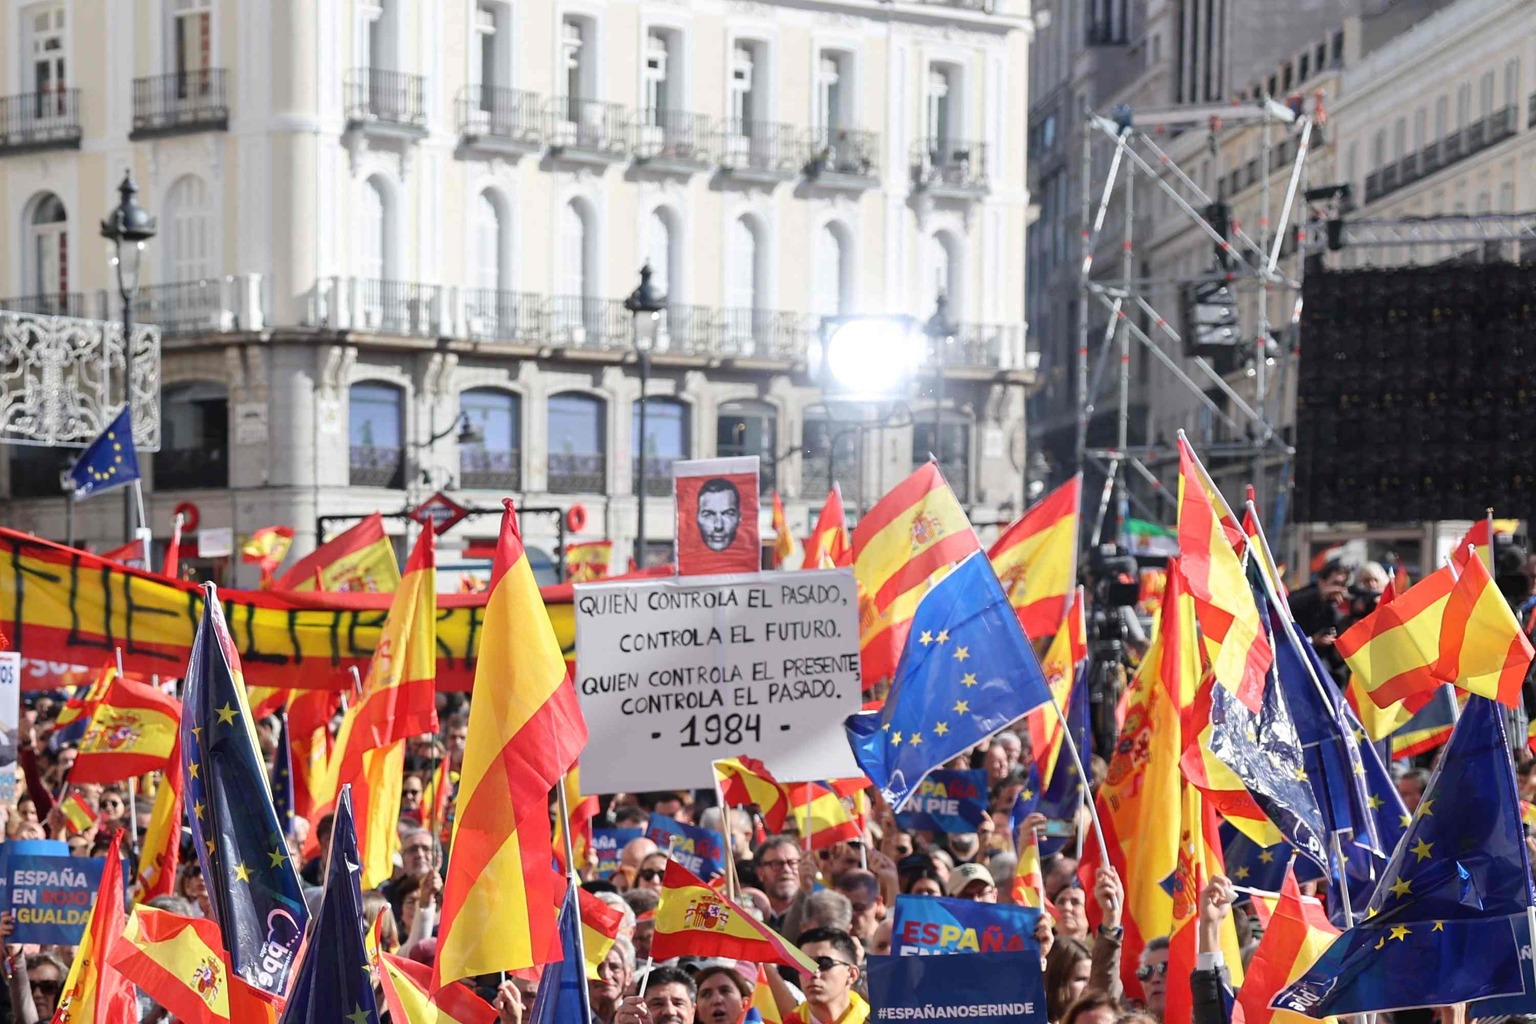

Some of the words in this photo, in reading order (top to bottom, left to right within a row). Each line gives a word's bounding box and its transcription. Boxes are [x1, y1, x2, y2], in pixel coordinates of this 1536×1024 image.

[579, 591, 637, 617] QUIEN
[648, 589, 738, 611] CONTROLA
[747, 588, 773, 608] EL
[619, 626, 722, 653] CONTROLA
[731, 625, 754, 643] EL
[766, 619, 841, 642] FUTURO.
[581, 673, 639, 696] QUIEN
[648, 665, 743, 690] CONTROLA
[752, 661, 774, 681] EL
[621, 689, 724, 715] CONTROLA
[734, 687, 758, 706] EL
[768, 679, 842, 703] PASADO.
[679, 713, 761, 748] 1984
[927, 798, 960, 815] PIE
[13, 867, 88, 888] ESPAÑA
[11, 889, 36, 904] EN
[41, 890, 89, 906] ROJO
[902, 920, 1024, 953] ESPAÑA
[877, 1002, 1035, 1020] #ESPAÑANOSERINDE
